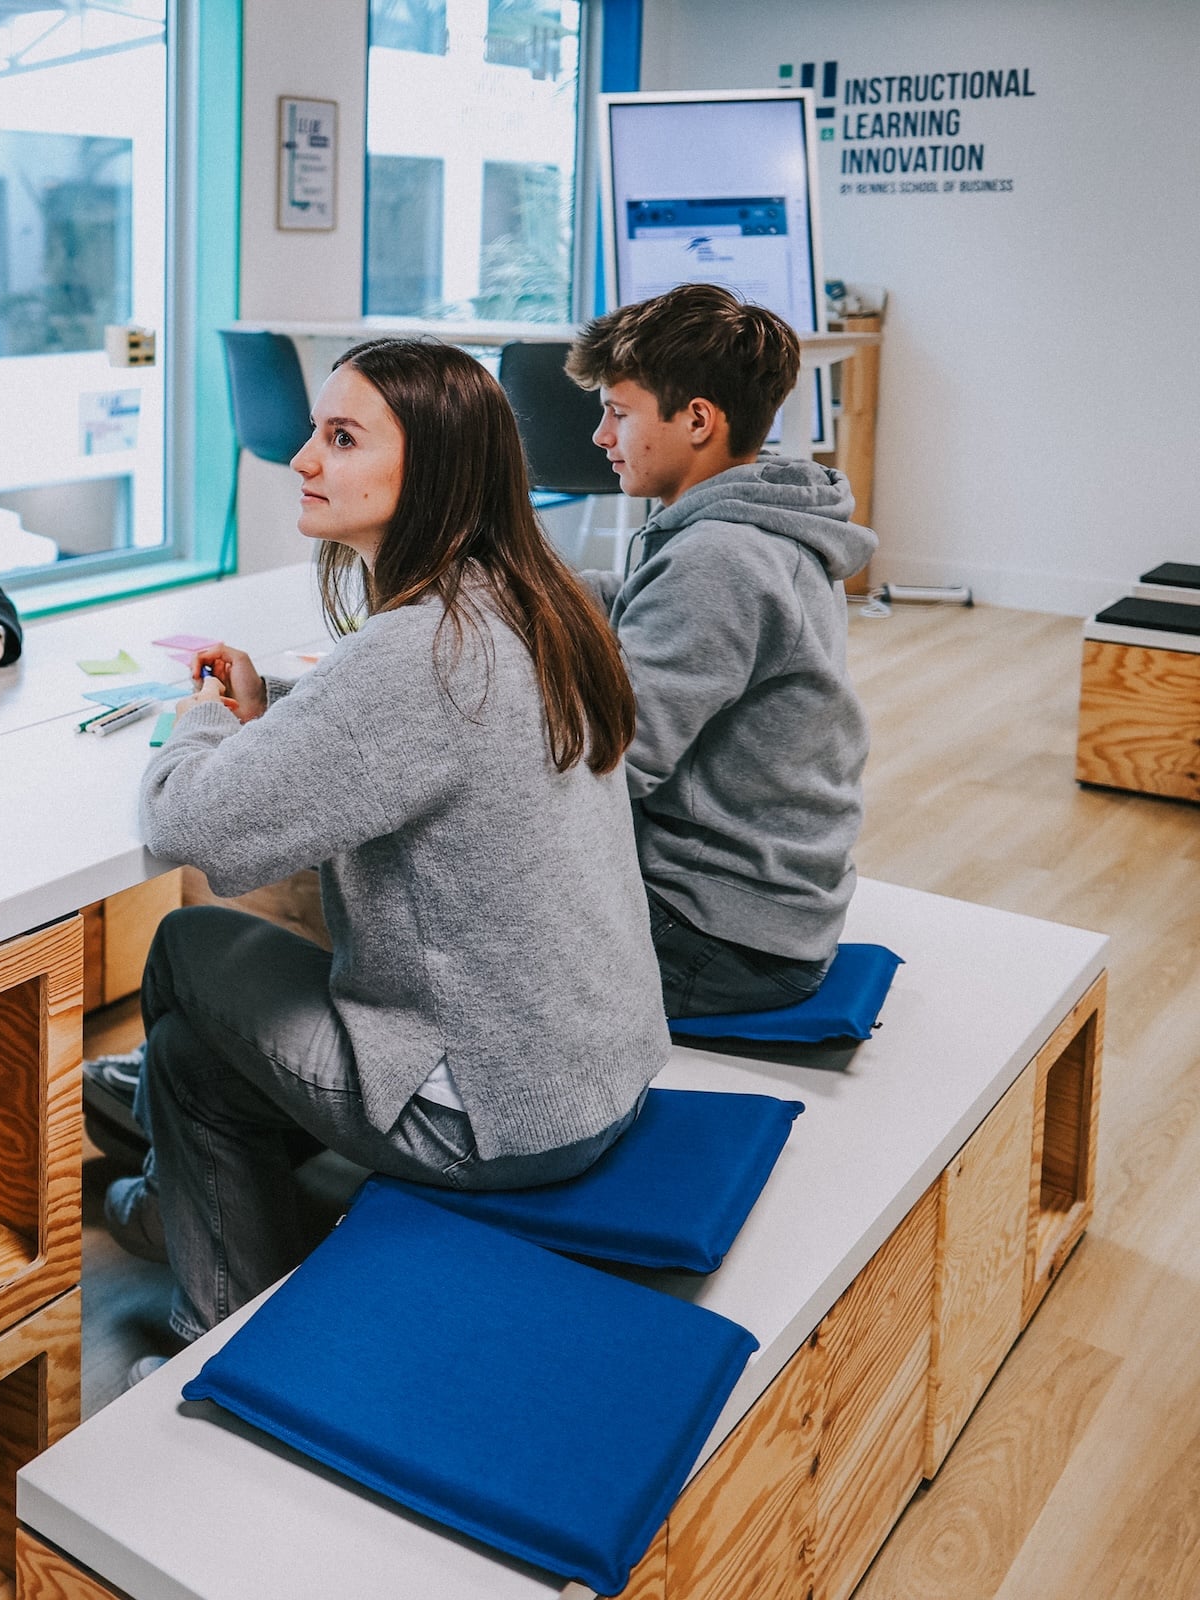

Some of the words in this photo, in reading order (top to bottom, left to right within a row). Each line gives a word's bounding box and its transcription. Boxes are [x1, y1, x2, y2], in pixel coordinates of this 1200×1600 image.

[844, 68, 1036, 105] INSTRUCTIONAL
[843, 109, 960, 140] LEARNING
[841, 144, 984, 174] INNOVATION
[900, 181, 939, 193] SCHOOL
[944, 180, 957, 192] OF
[959, 179, 1014, 192] BUSINESS
